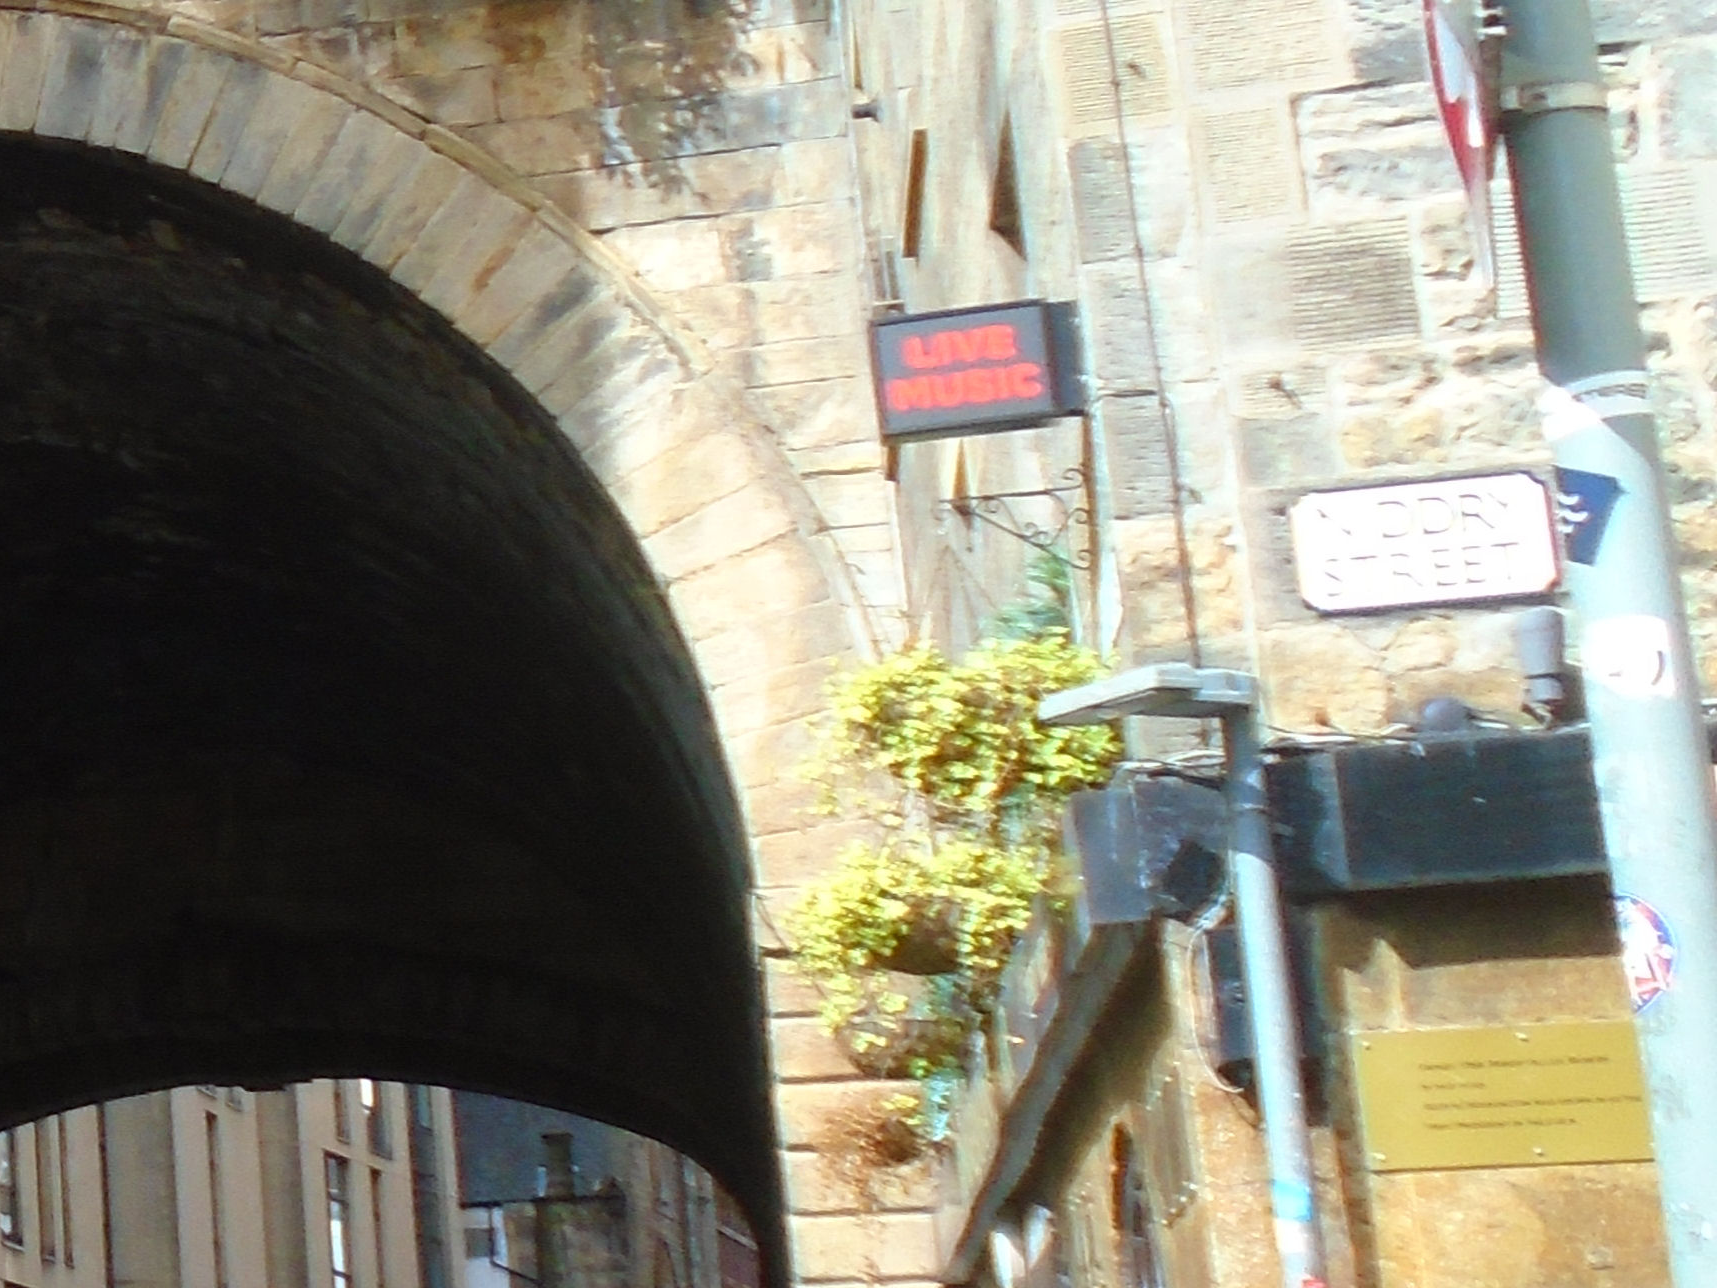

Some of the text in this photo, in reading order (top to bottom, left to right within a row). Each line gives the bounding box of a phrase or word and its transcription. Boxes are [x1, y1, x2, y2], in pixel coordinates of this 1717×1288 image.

[902, 324, 1018, 370] LIVE
[888, 362, 1044, 411] MUSIC
[1314, 491, 1511, 540] NDDRY
[1323, 541, 1522, 599] STREET
